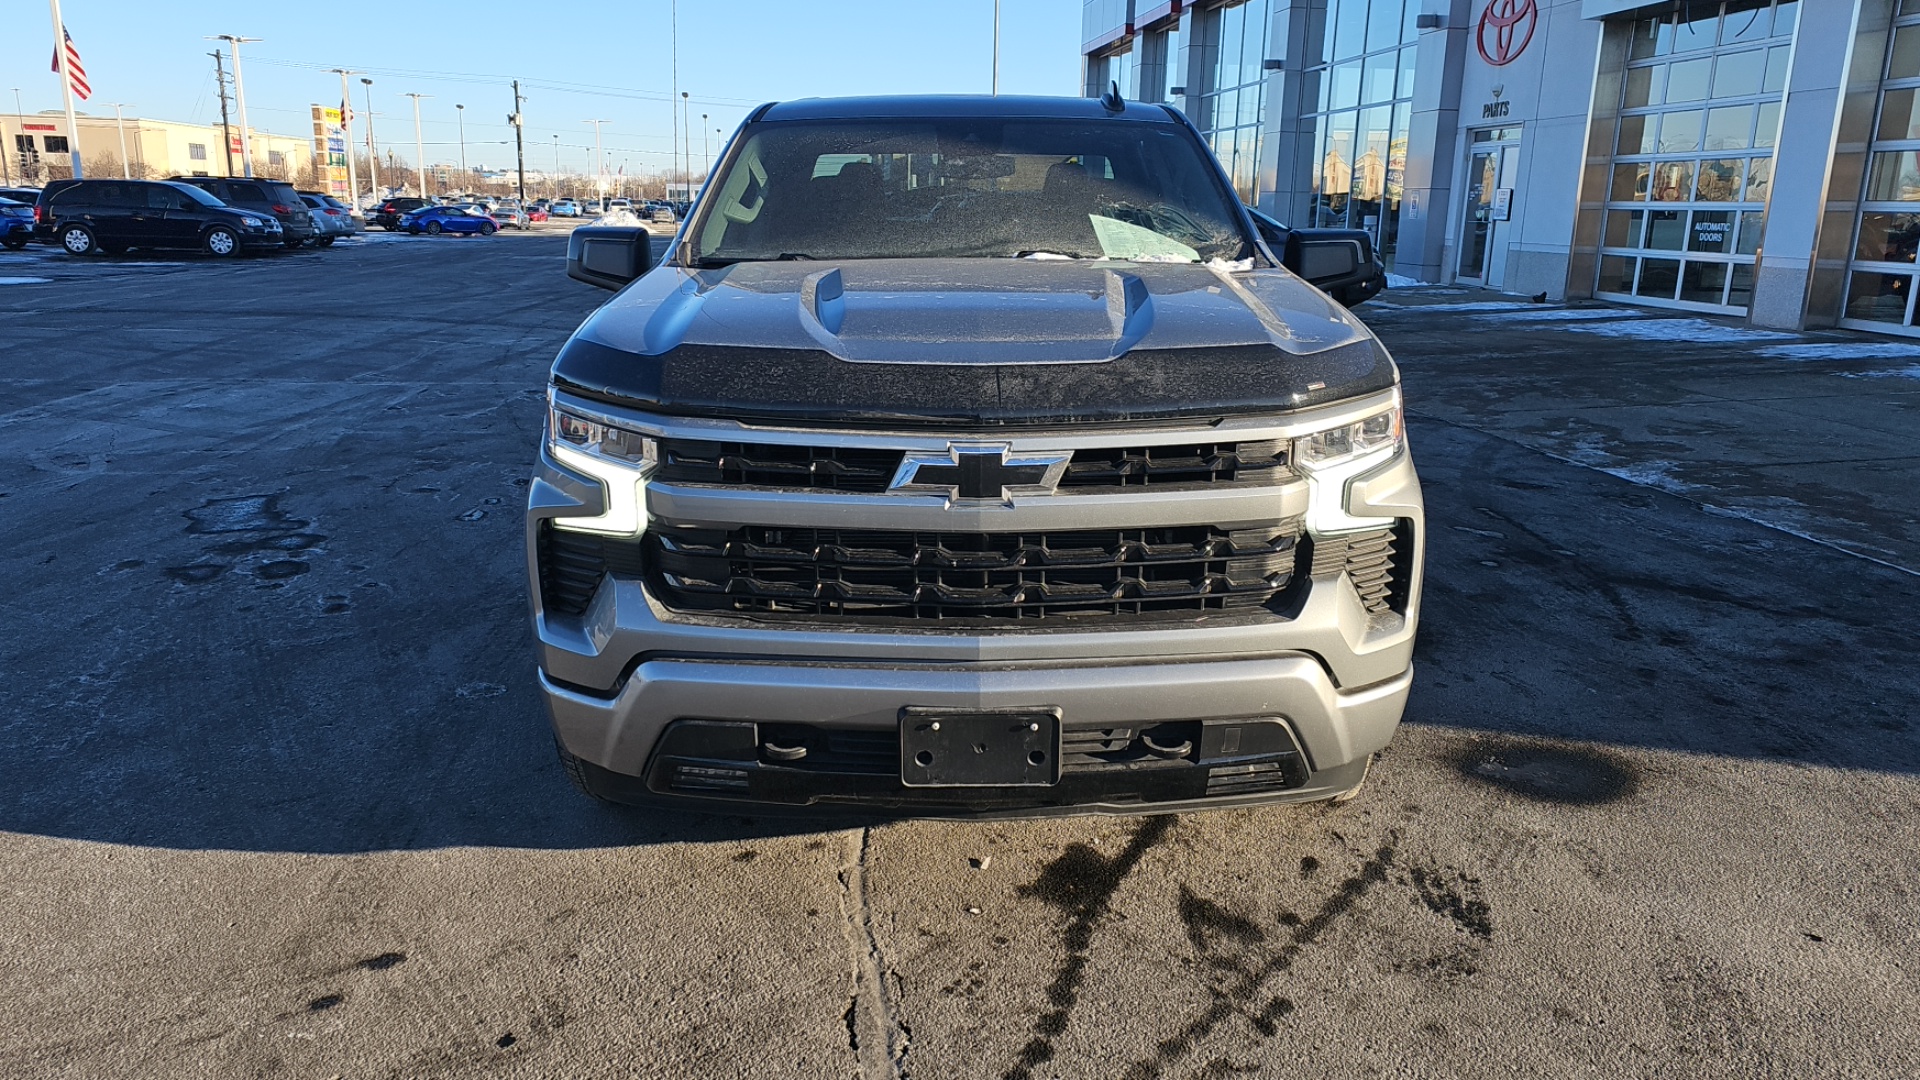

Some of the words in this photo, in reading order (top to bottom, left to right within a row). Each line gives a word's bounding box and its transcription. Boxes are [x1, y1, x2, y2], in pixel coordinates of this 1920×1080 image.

[1482, 100, 1510, 119] PARTS
[1694, 222, 1731, 232] AUTOMATIC
[1699, 232, 1722, 242] DOORS
